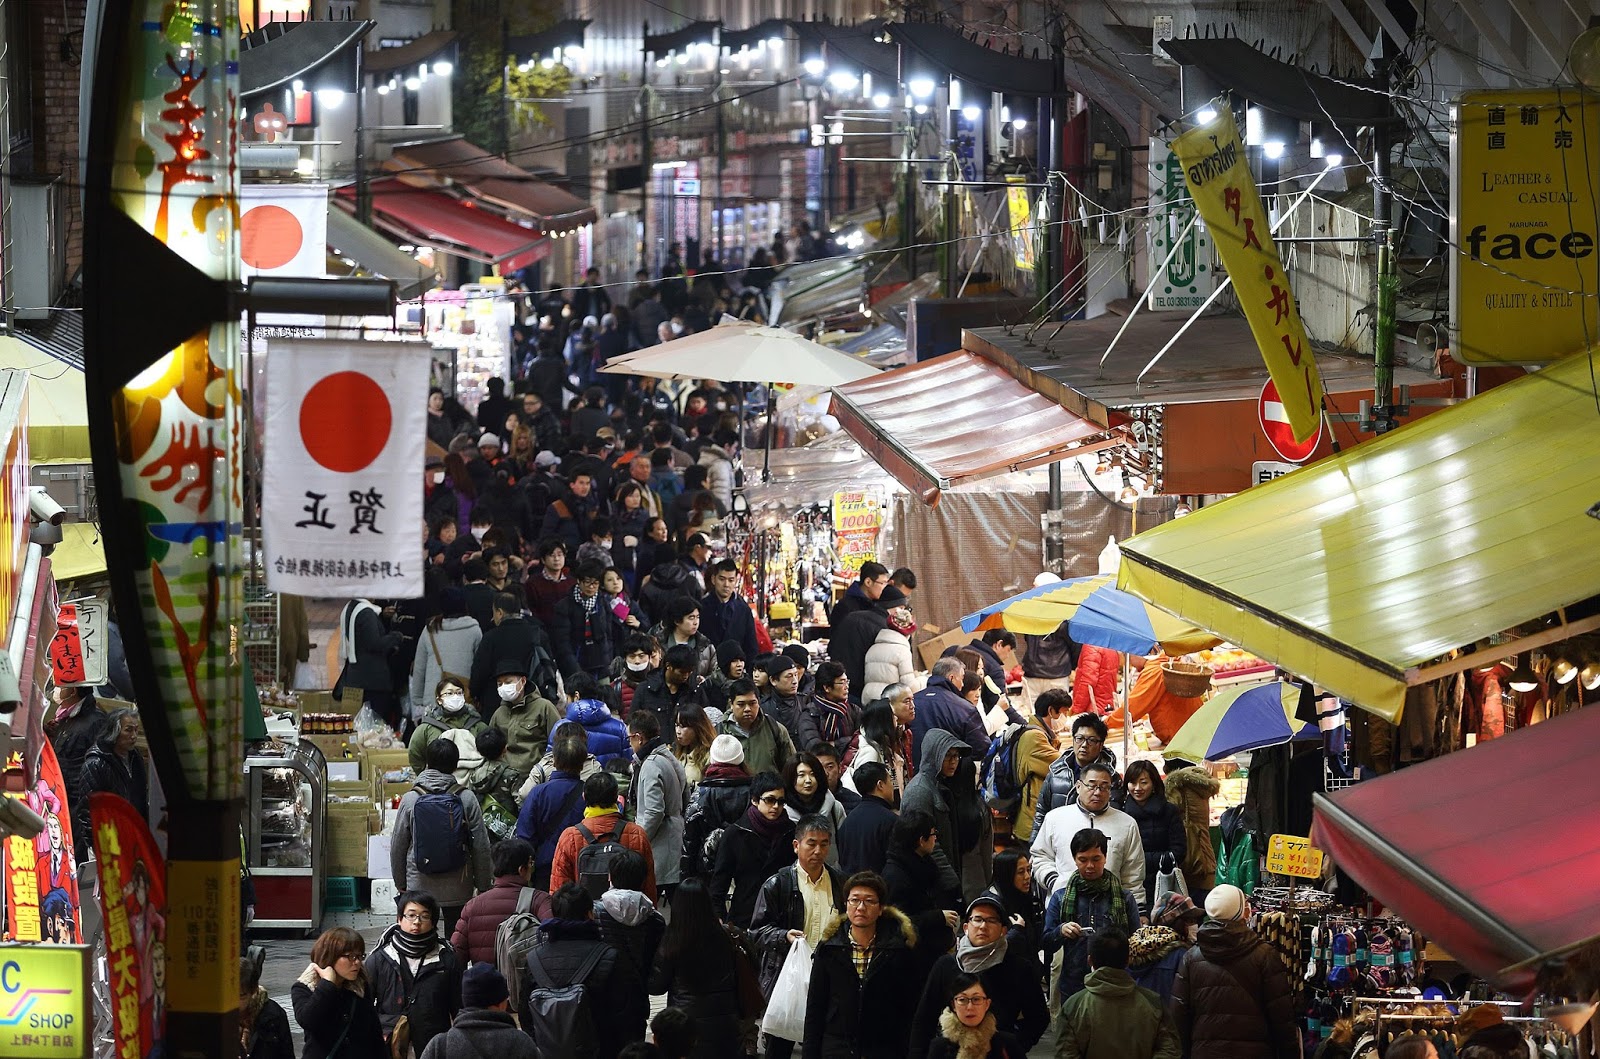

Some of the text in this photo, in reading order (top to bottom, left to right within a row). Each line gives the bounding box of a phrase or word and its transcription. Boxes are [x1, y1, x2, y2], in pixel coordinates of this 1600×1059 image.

[1487, 106, 1573, 126] 直輸入
[1482, 172, 1552, 192] LEATHER &
[1518, 191, 1578, 204] CASUAL
[1509, 221, 1549, 229] MARUNAGA
[1465, 225, 1594, 261] face
[1485, 292, 1573, 310] QUALITY & STYLE
[81, 607, 97, 660] テント
[30, 1013, 74, 1029] SHOP
[10, 1034, 74, 1047] 上野4丁目店
